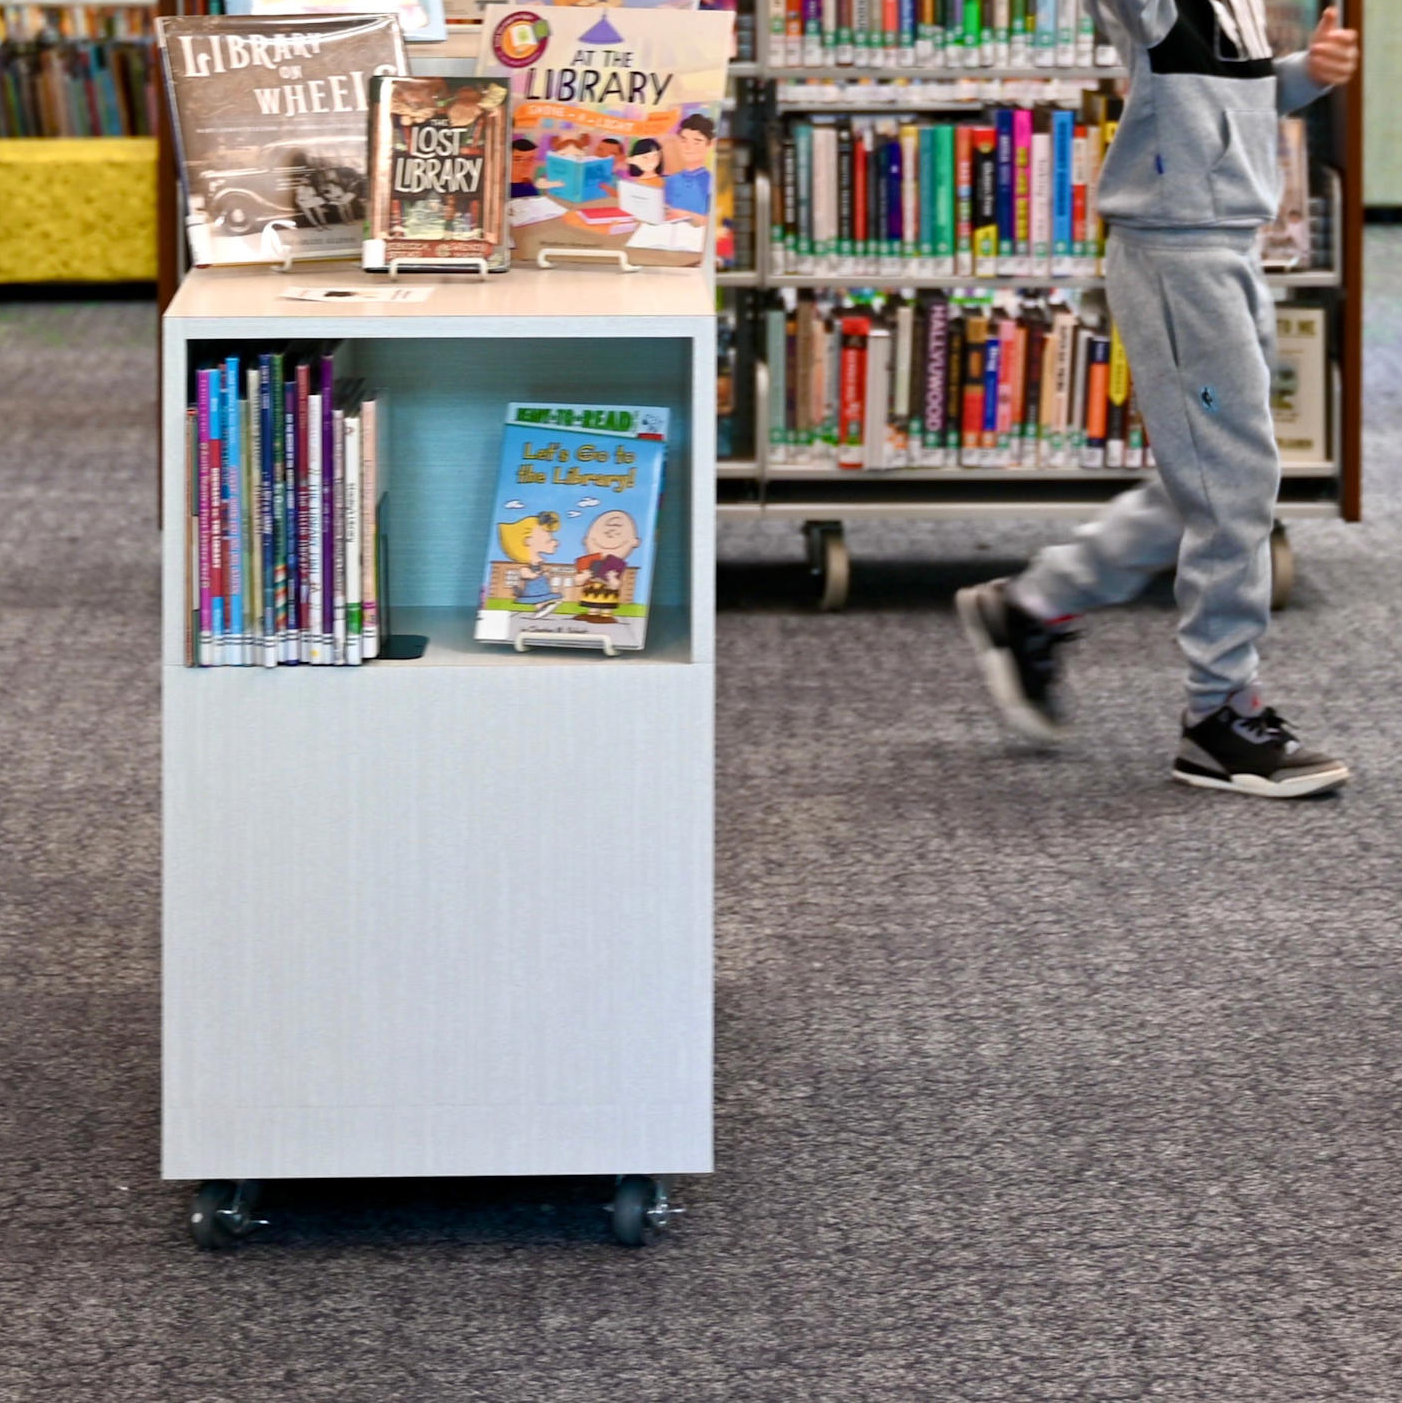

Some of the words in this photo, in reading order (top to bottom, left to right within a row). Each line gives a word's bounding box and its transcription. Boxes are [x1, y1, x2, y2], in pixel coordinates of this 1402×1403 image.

[178, 32, 322, 78] LIBRARY
[570, 50, 596, 66] AT
[602, 50, 634, 68] THE
[526, 67, 674, 105] LIBRARY
[410, 126, 468, 159] LOST
[394, 157, 483, 194] LIBRARY
[925, 304, 947, 432] HALLYUWOOD
[522, 442, 569, 462] Let's
[576, 444, 609, 463] Go
[615, 445, 637, 464] to
[517, 464, 546, 484] the
[552, 466, 637, 493] Library!
